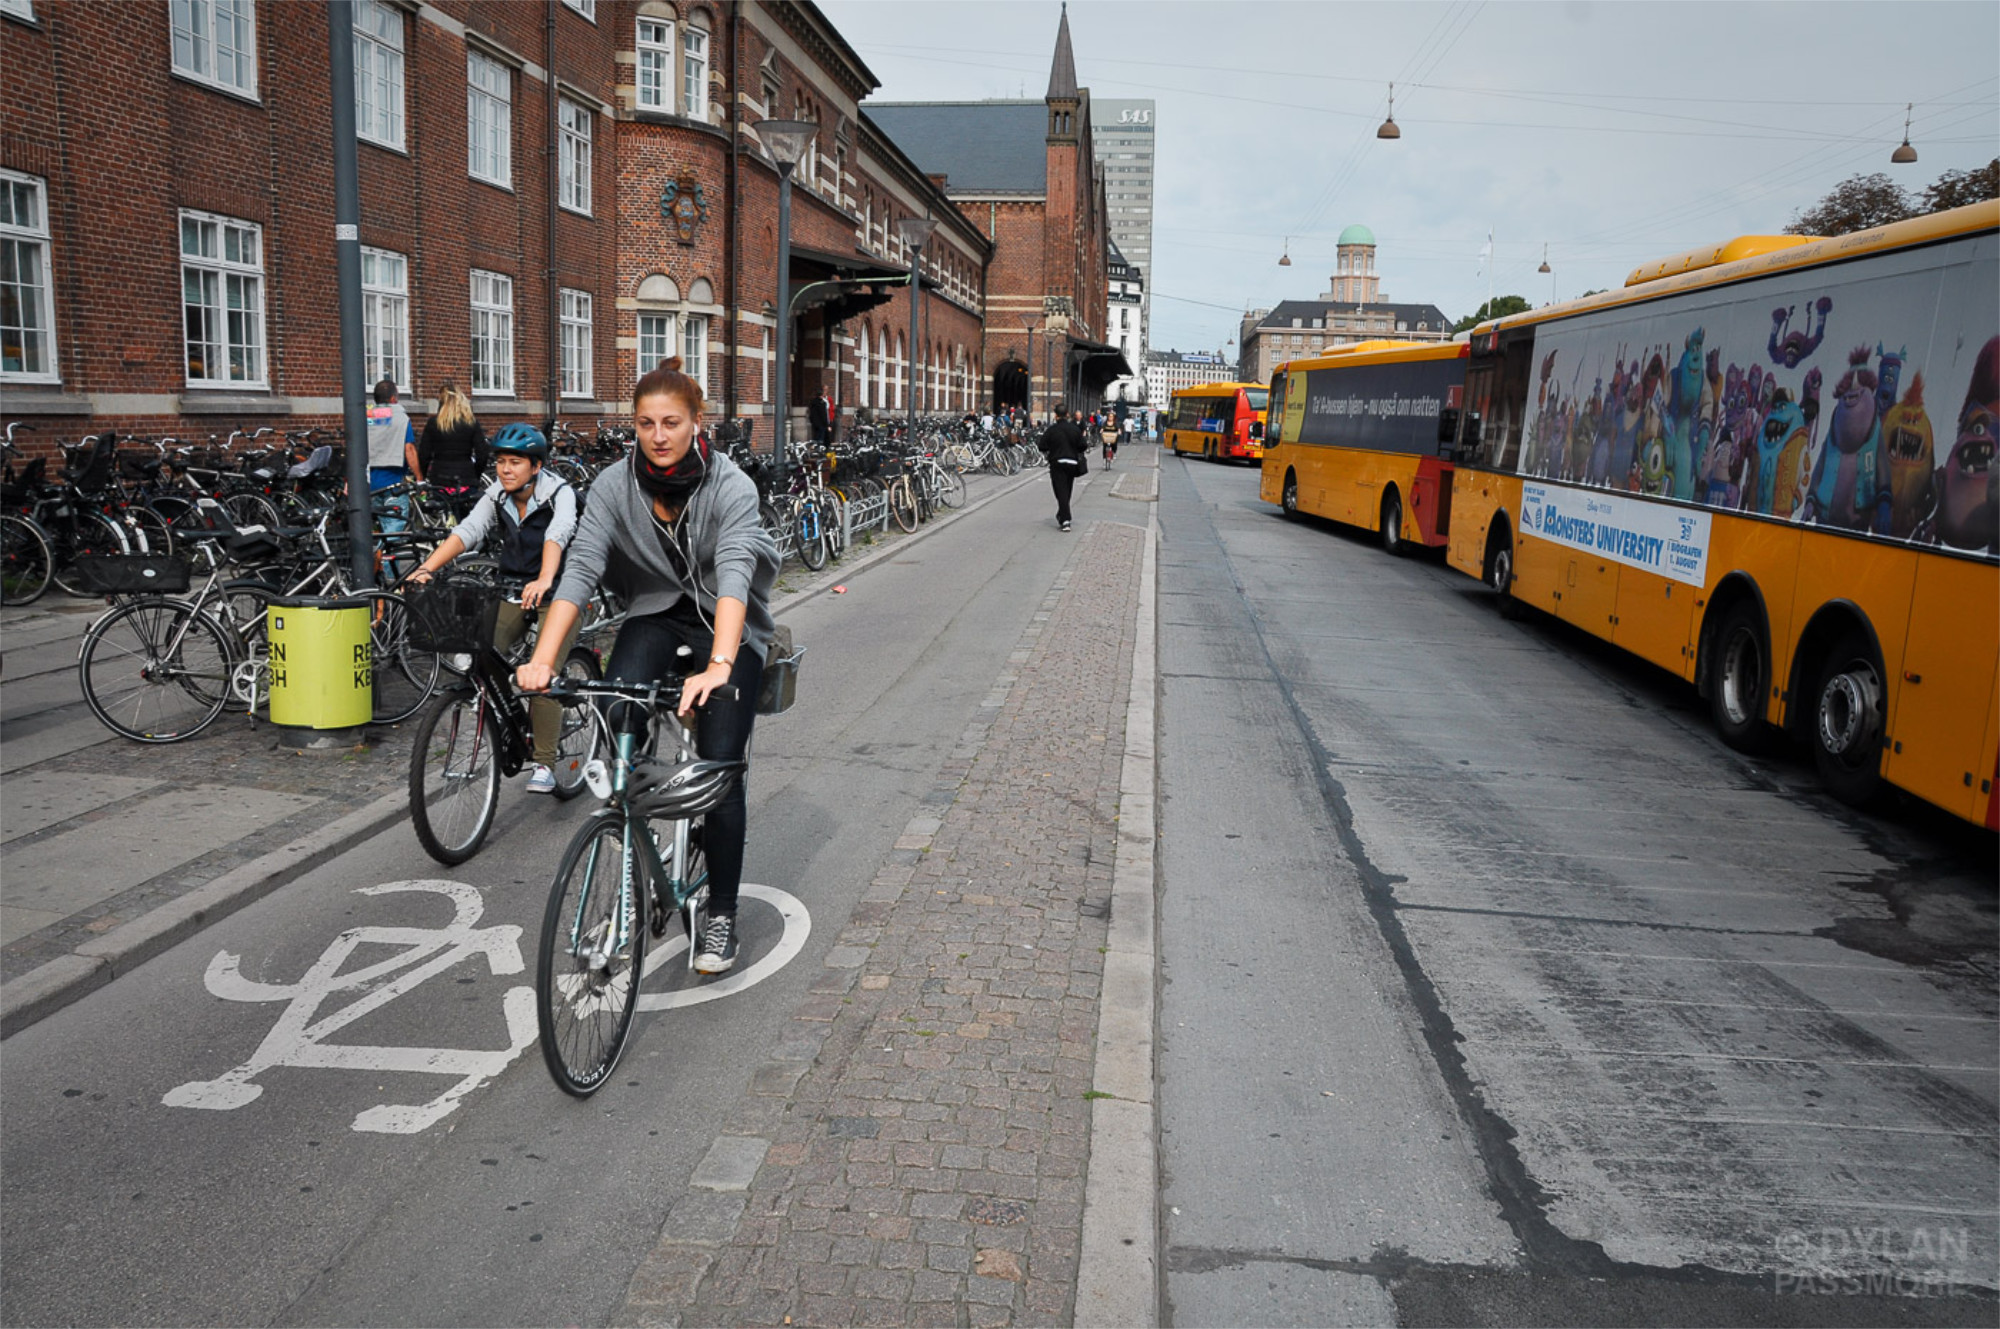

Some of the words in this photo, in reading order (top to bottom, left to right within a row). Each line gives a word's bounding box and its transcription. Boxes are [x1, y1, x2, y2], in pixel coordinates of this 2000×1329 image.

[1117, 109, 1152, 124] SAS
[1378, 392, 1397, 421] også
[1397, 398, 1411, 416] om
[1410, 395, 1441, 417] natten
[1543, 504, 1596, 546] MONSTERS
[1596, 524, 1664, 566] UNIVERSITY
[1671, 542, 1702, 559] BIOGRAFEN
[1676, 556, 1698, 571] AUGUST
[268, 641, 287, 662] EN
[353, 642, 371, 663] RE
[353, 668, 371, 689] KB
